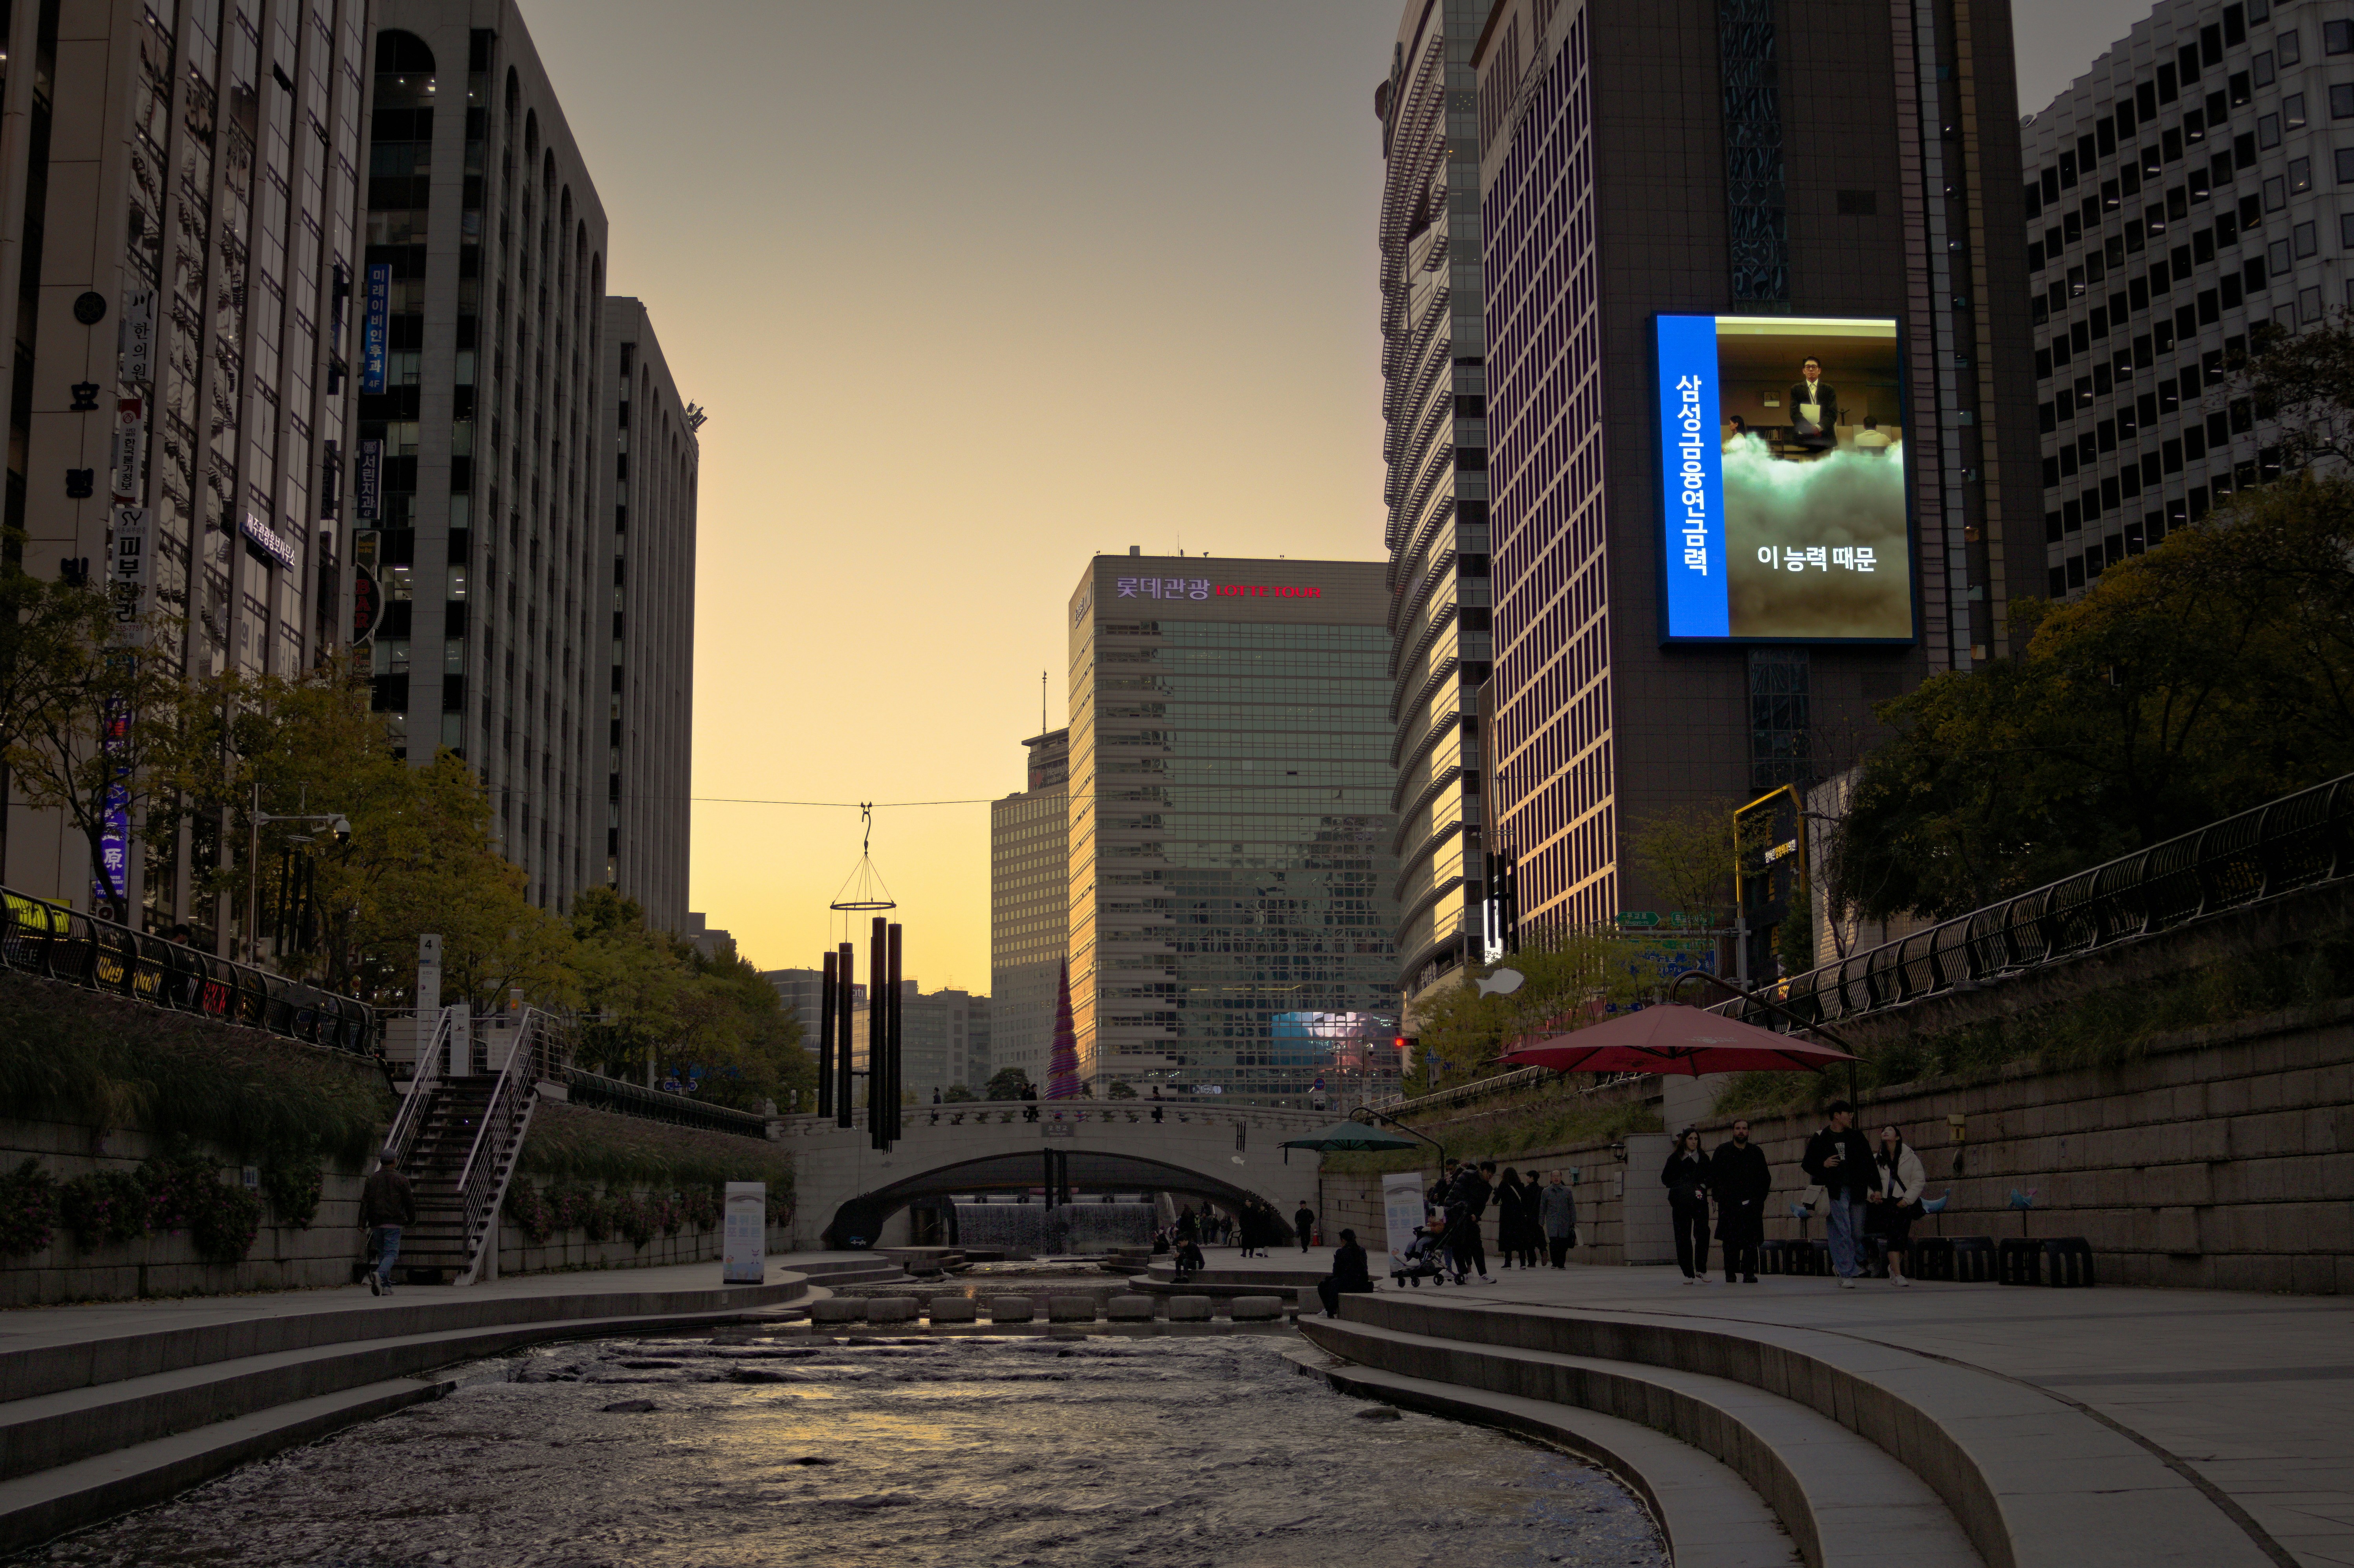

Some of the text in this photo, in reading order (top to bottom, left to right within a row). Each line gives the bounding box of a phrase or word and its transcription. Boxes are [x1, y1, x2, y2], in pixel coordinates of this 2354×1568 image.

[369, 270, 385, 373] 미래이비인후과
[360, 454, 376, 509] 서린치과
[1676, 375, 1708, 576] 삼성금융연금력
[121, 511, 143, 526] SY
[247, 512, 295, 566] 제주관광홍보사무소
[1758, 546, 1877, 572] 이 능력 때문
[354, 579, 371, 628] BAR
[1116, 577, 1321, 600] 롯데관광 LOTTE TOUR
[1765, 839, 1795, 863] 참바른정형외과의원
[425, 940, 432, 949] 4
